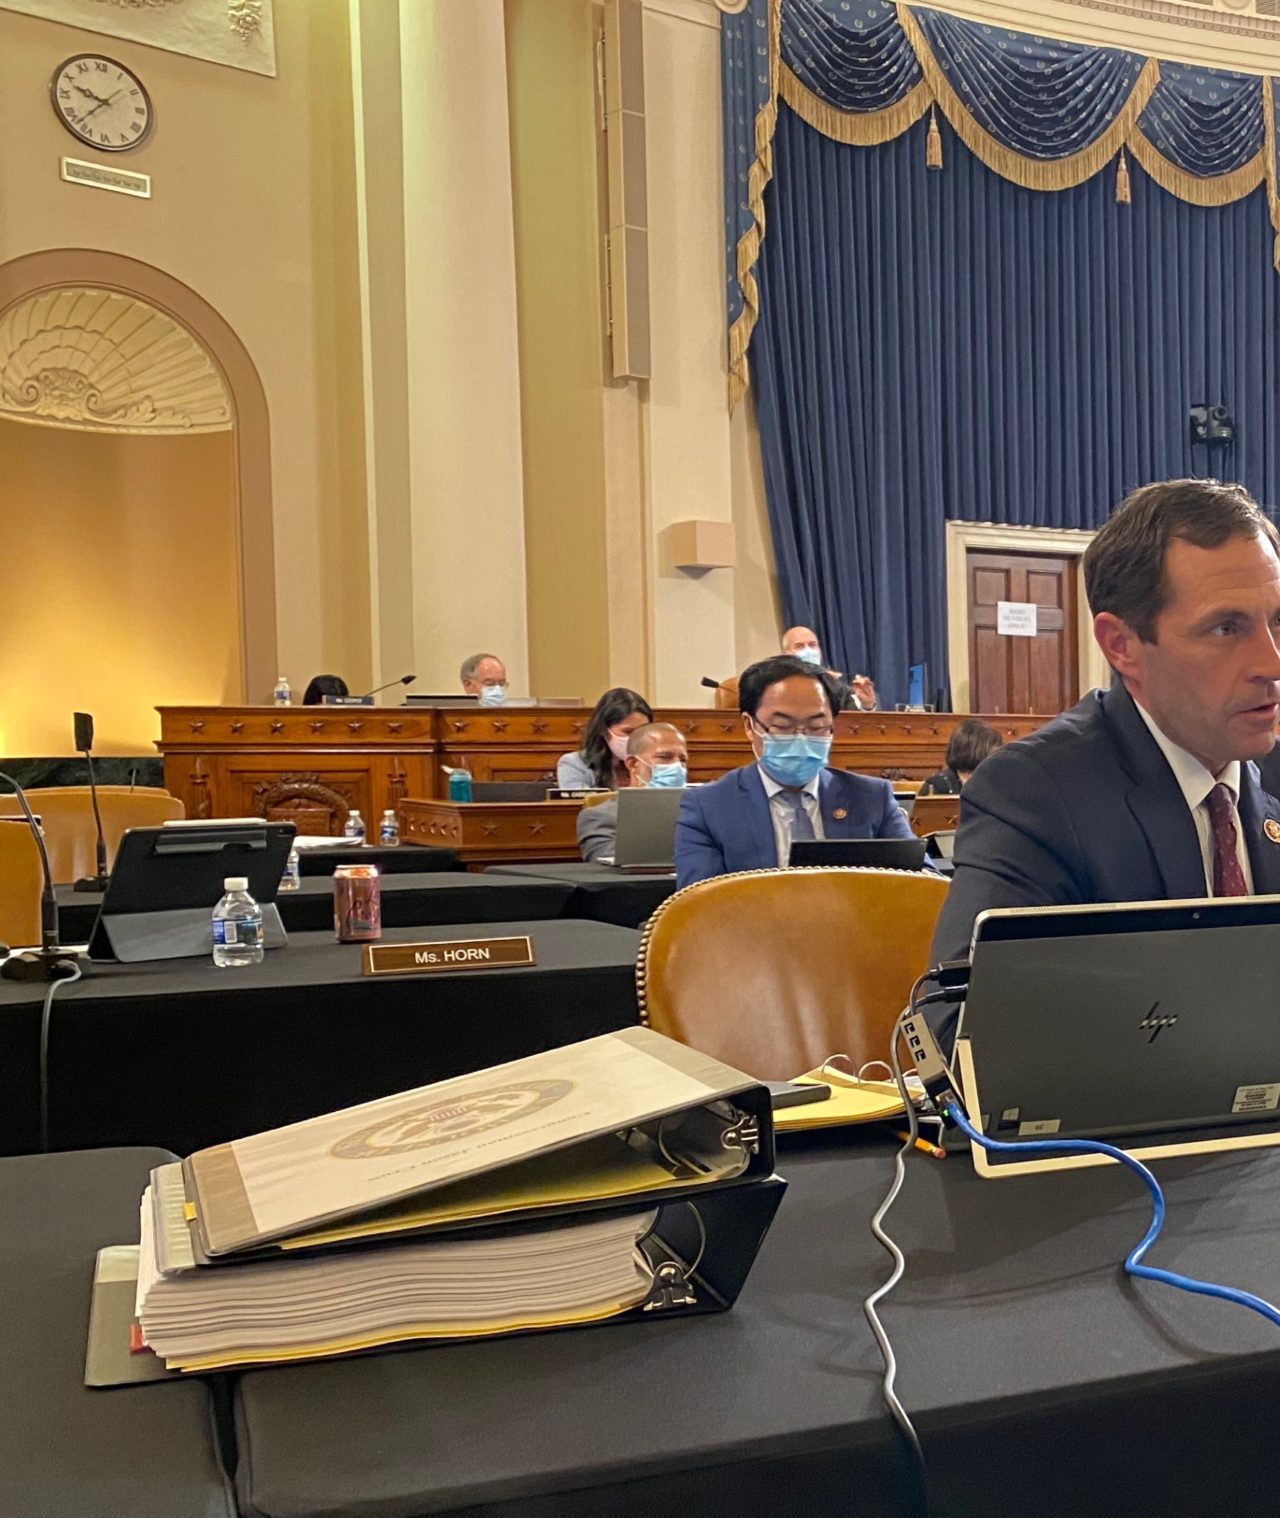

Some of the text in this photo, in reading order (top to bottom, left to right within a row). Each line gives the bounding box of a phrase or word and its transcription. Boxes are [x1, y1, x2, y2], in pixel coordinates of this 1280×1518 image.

[76, 62, 89, 73] XI
[95, 62, 108, 73] XII
[63, 73, 75, 82] X
[60, 88, 71, 99] IX
[101, 133, 110, 143] VI
[120, 133, 129, 142] V
[414, 948, 491, 964] Ms. HORN
